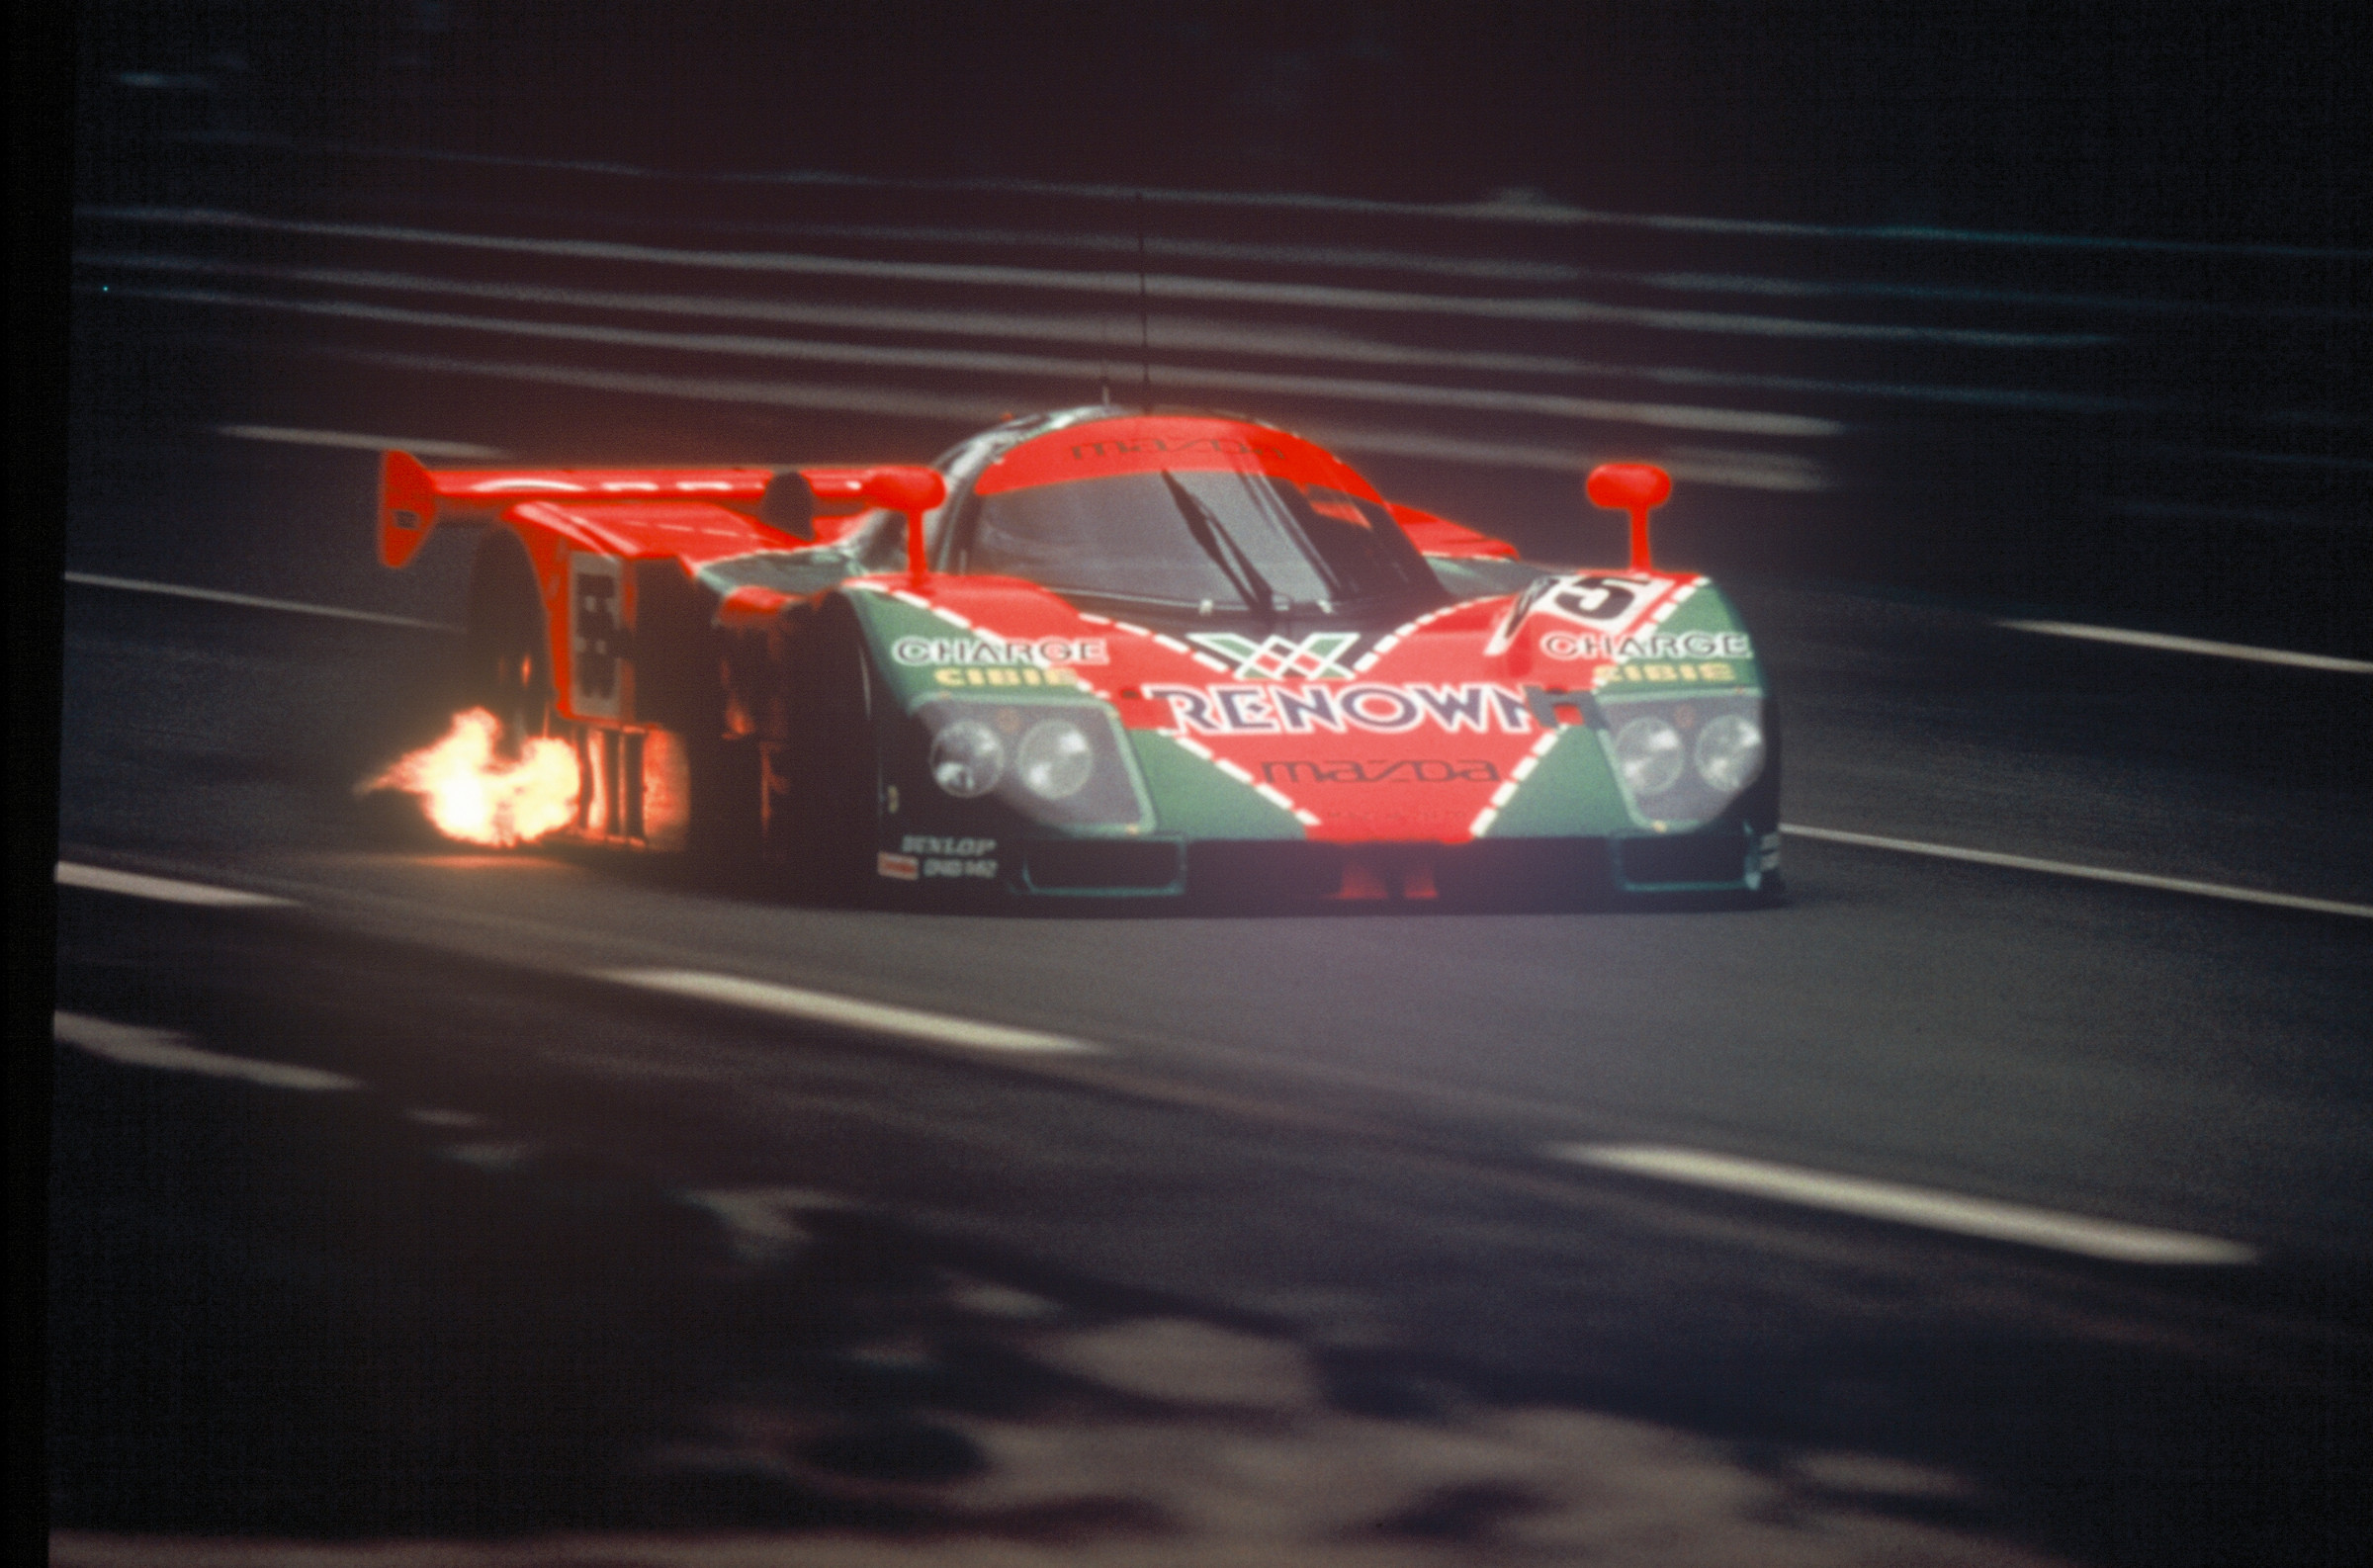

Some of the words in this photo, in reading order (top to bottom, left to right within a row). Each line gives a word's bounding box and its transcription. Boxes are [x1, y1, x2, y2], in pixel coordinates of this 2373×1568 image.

[891, 635, 1110, 665] CHARGE
[1539, 629, 1753, 660] CHARGE
[934, 666, 1079, 687] CIBIE
[1593, 662, 1735, 682] CIBIE
[1140, 681, 1542, 736] RENOWN
